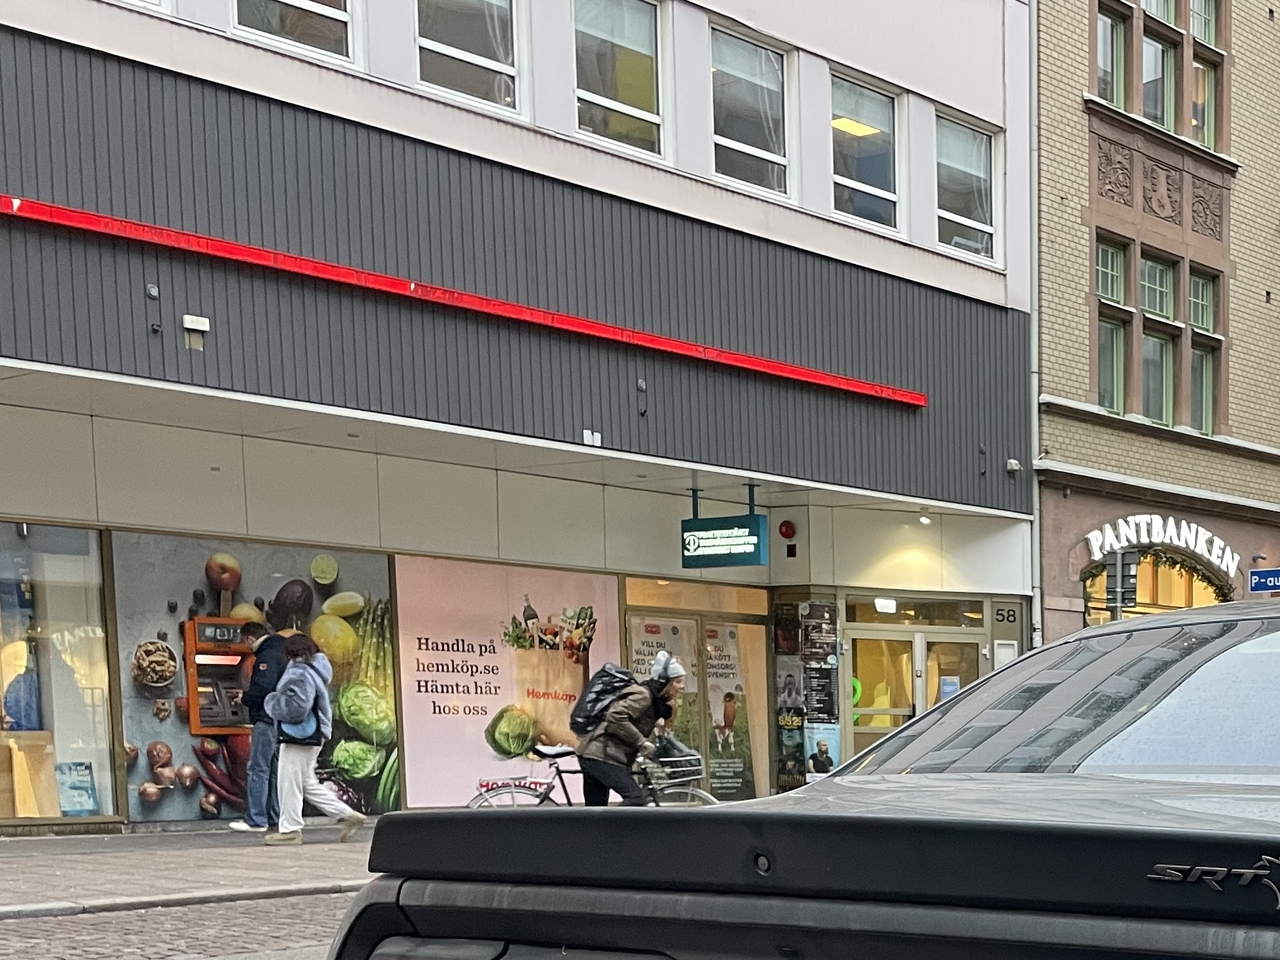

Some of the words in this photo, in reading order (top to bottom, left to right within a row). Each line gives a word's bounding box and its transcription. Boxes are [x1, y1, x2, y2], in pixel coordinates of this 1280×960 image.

[1085, 514, 1241, 578] PANTBANKEN
[995, 609, 1017, 623] 58
[416, 637, 476, 653] Handla
[478, 639, 498, 656] på
[641, 639, 655, 648] VILL
[656, 641, 666, 649] DU
[416, 658, 500, 677] hemköp.se
[416, 679, 471, 694] Hämta
[474, 681, 501, 695] här
[526, 687, 577, 703] Hemköp
[432, 700, 460, 715] hos
[463, 704, 488, 716] oss
[1147, 864, 1270, 891] SRT
